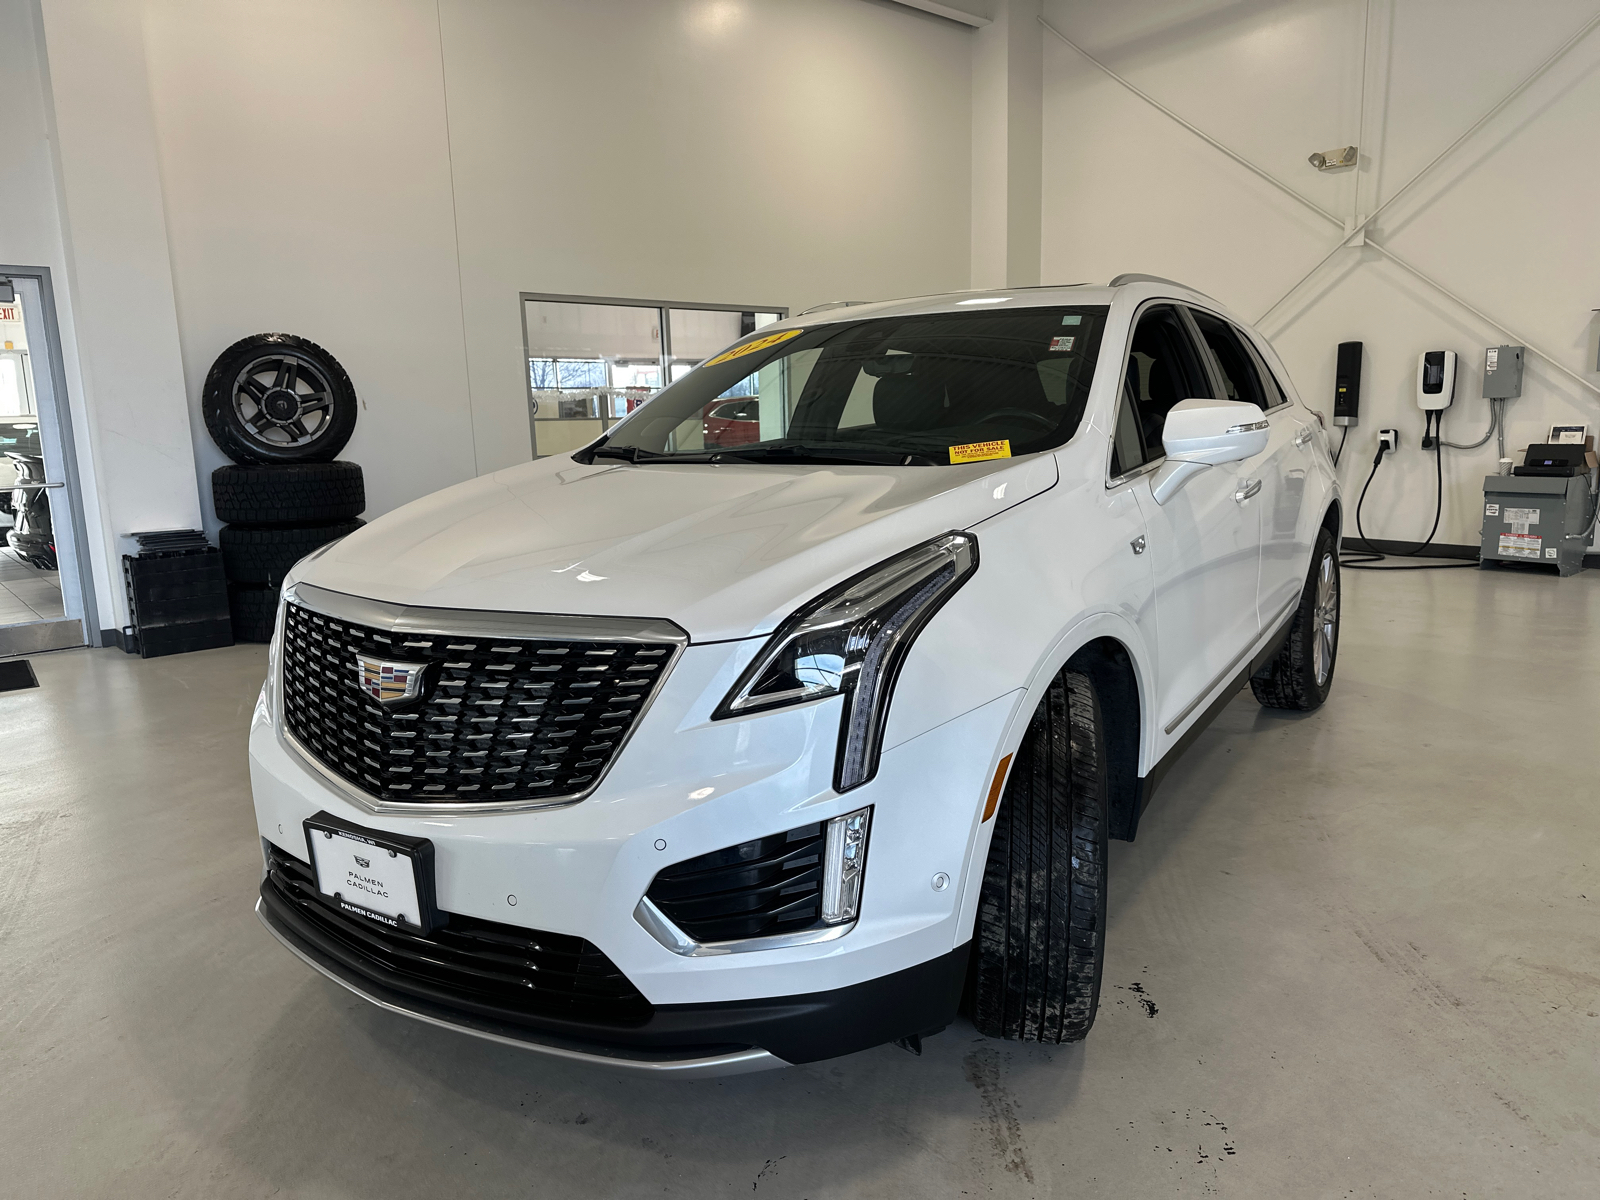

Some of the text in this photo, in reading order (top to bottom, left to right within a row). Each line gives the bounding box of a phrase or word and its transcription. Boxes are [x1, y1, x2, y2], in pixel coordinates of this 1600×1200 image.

[716, 332, 789, 364] 2024
[972, 441, 1006, 449] VEHICLE
[348, 871, 384, 888] PALMEN
[346, 880, 389, 898] CADILLAC
[340, 902, 398, 927] PALMEN CADILLAC
